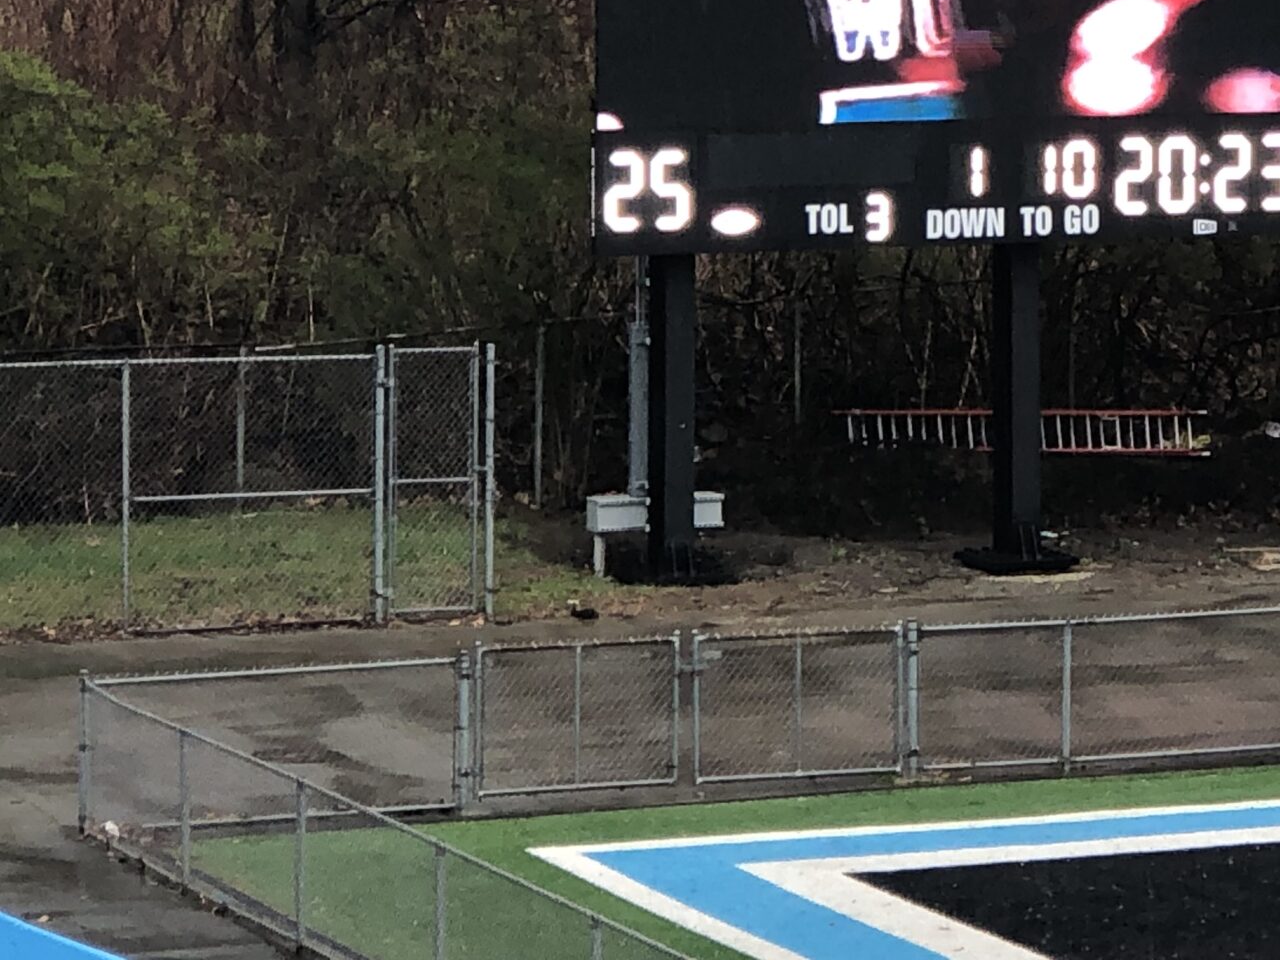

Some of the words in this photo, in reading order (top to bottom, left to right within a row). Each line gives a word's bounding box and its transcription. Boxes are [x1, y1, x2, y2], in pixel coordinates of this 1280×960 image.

[603, 149, 695, 232] 25
[969, 146, 985, 197] 1
[1043, 140, 1096, 198] 10
[806, 204, 853, 235] TOL
[865, 194, 892, 241] 3
[926, 207, 1004, 239] DOWN
[1021, 206, 1052, 236] TO
[1064, 204, 1099, 235] GO
